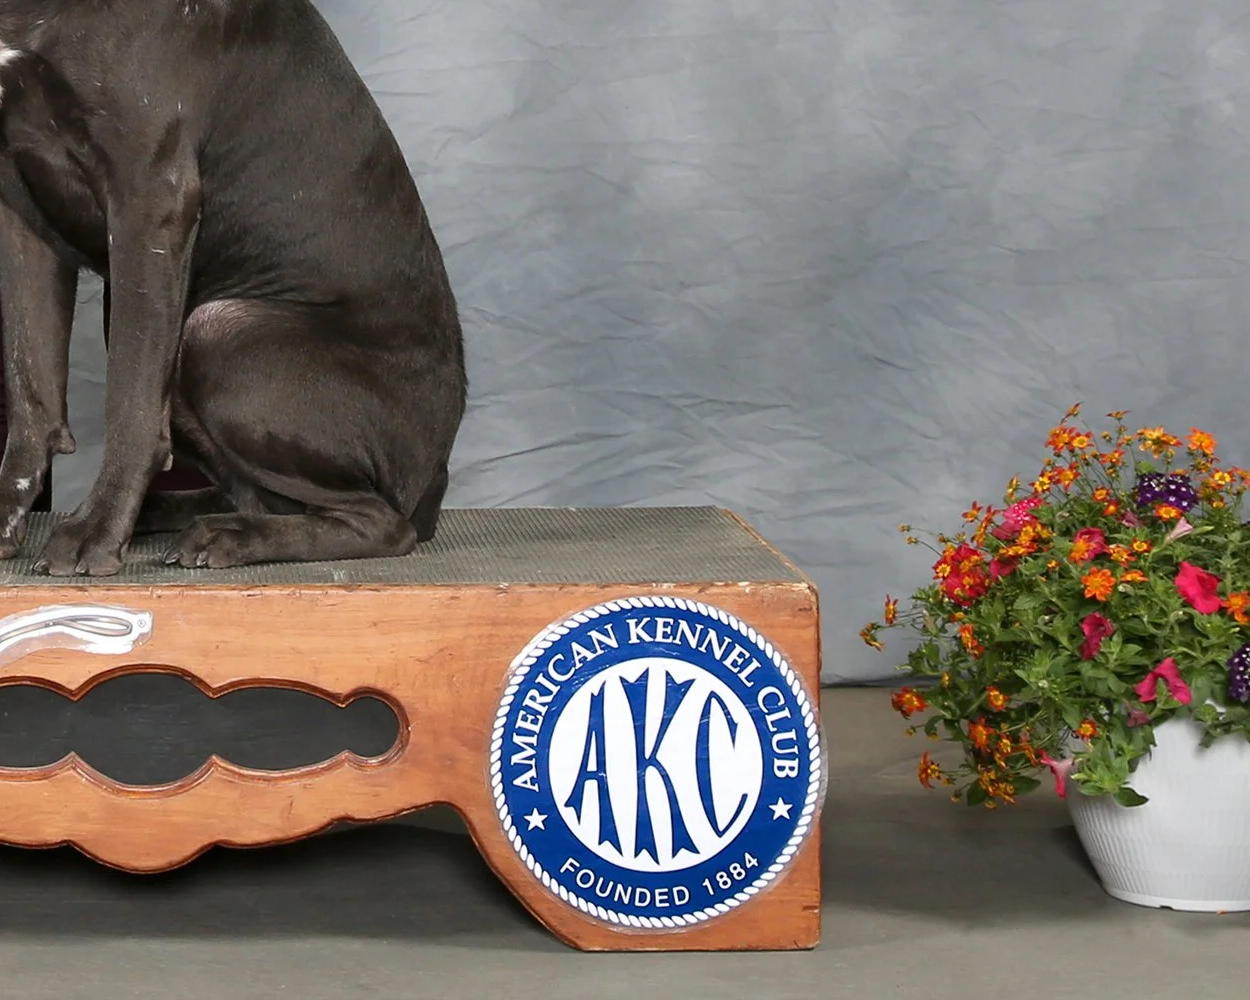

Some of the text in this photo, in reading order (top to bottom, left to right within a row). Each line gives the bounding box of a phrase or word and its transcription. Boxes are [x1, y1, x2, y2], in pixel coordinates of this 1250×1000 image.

[510, 616, 801, 792] AMERICAN KENNEL CLUB
[563, 666, 749, 866] AKC
[559, 851, 761, 909] FOUNDED 1884
